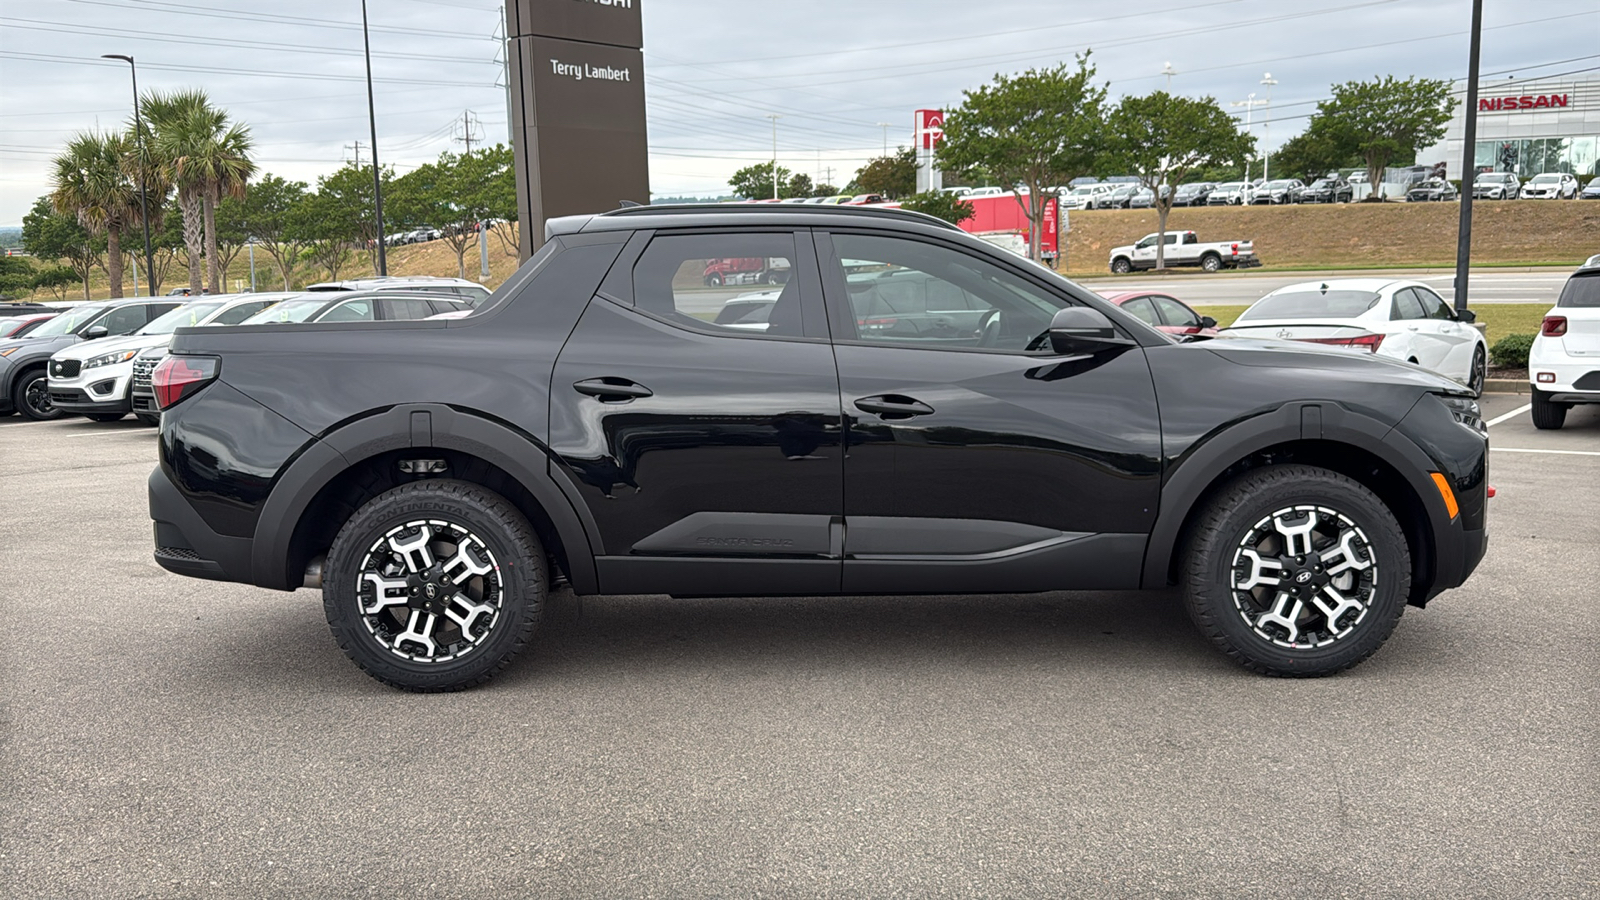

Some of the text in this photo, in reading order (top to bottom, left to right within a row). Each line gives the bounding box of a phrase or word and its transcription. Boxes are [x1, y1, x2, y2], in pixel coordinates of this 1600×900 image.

[550, 59, 630, 81] Terry Lambert
[1479, 94, 1567, 111] NISSAN
[366, 501, 473, 529] CONTINENTAL
[696, 536, 793, 548] SANTA CRUZ
